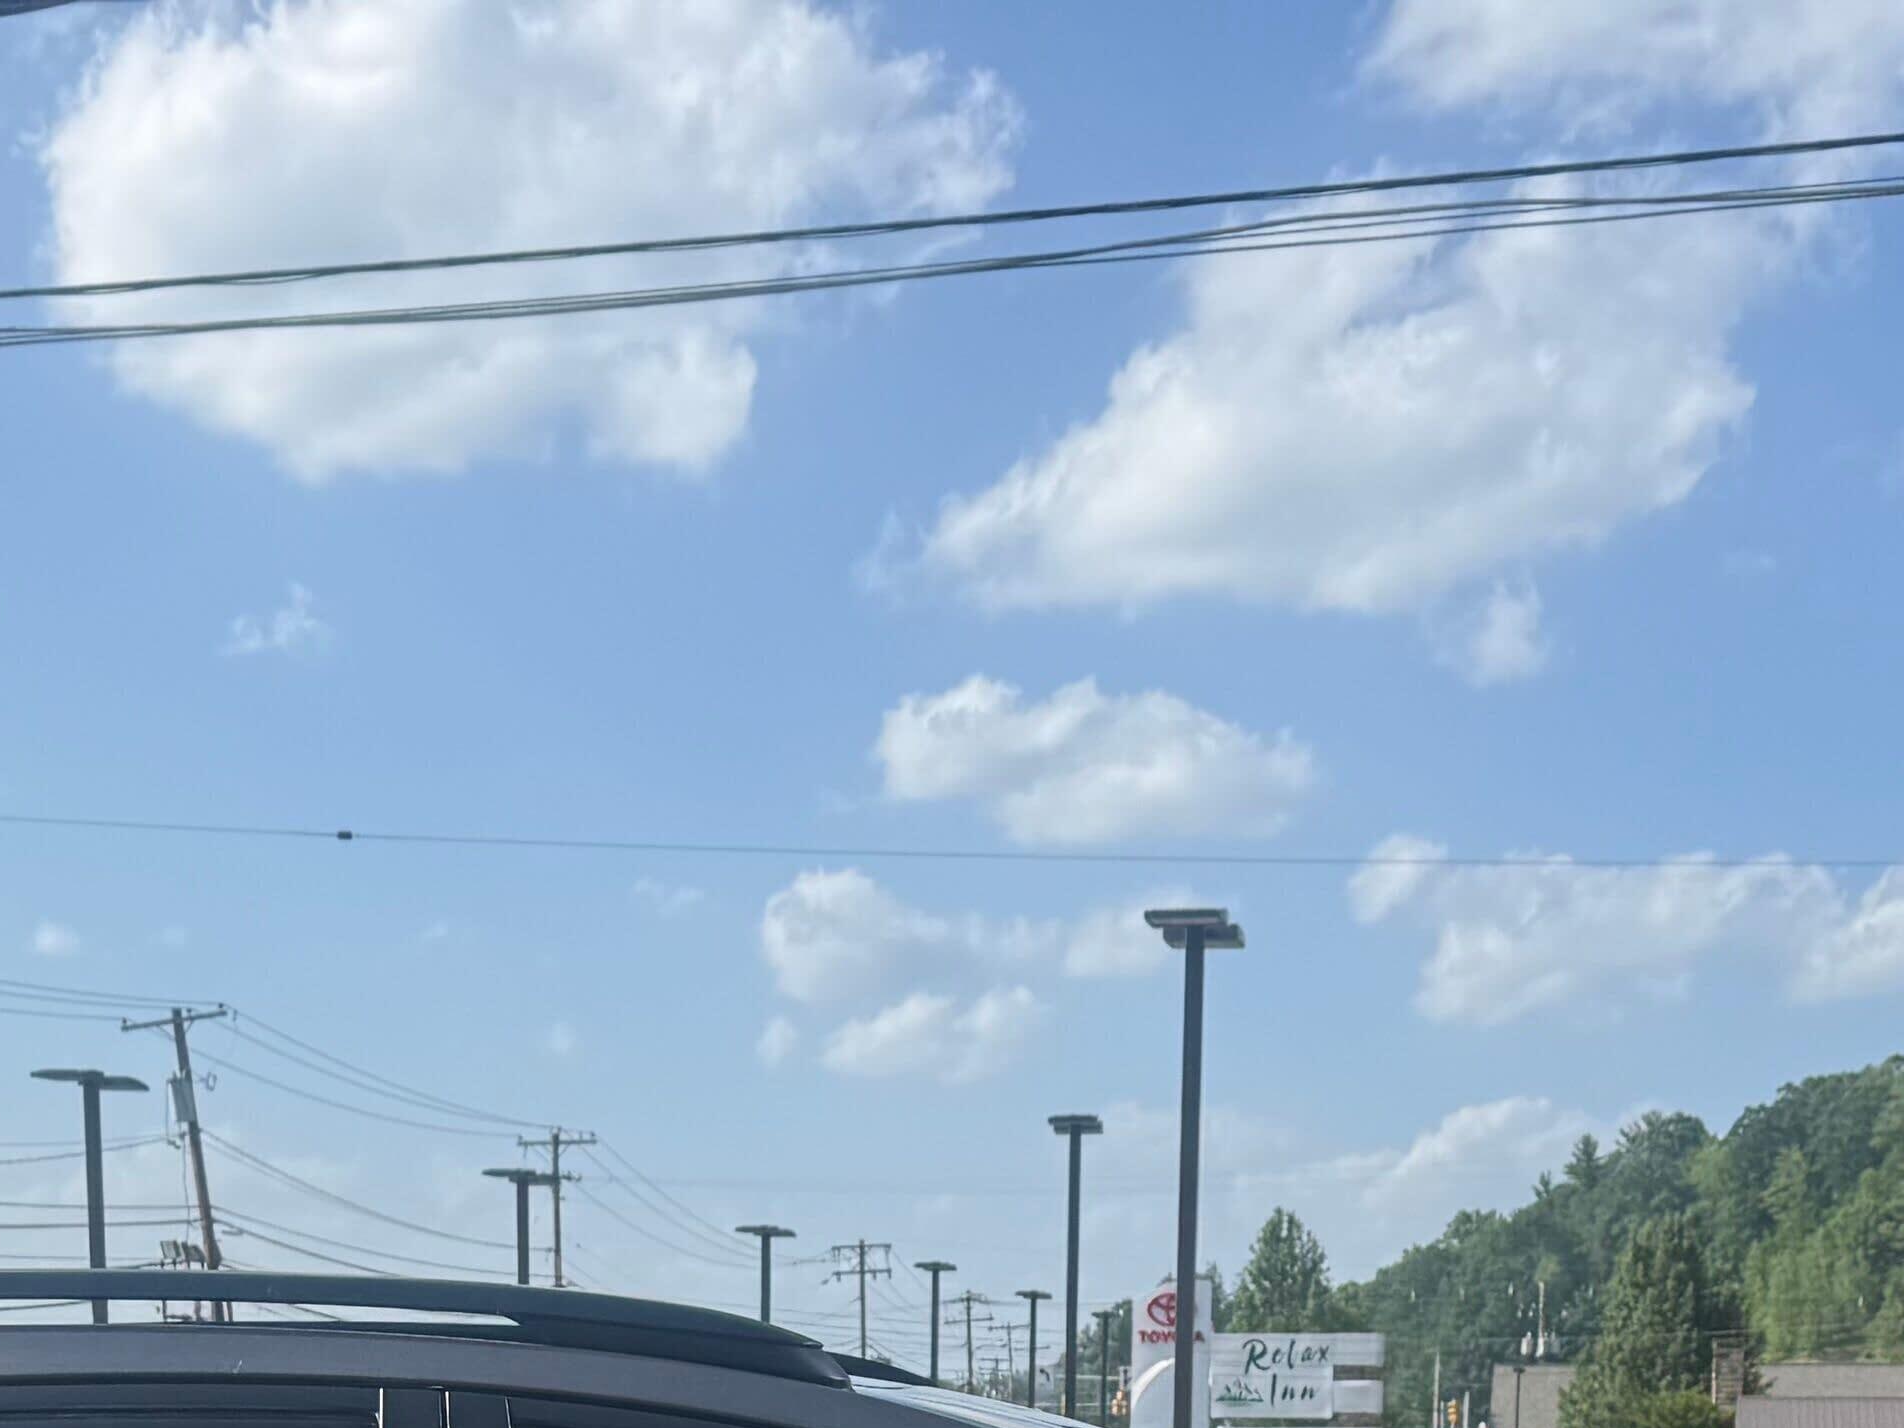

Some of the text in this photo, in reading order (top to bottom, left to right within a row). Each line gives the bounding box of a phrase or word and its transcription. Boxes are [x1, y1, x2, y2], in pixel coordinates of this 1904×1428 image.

[1138, 1330, 1205, 1344] TOYA
[1243, 1338, 1329, 1376] Relax
[1270, 1374, 1317, 1406] Inn
